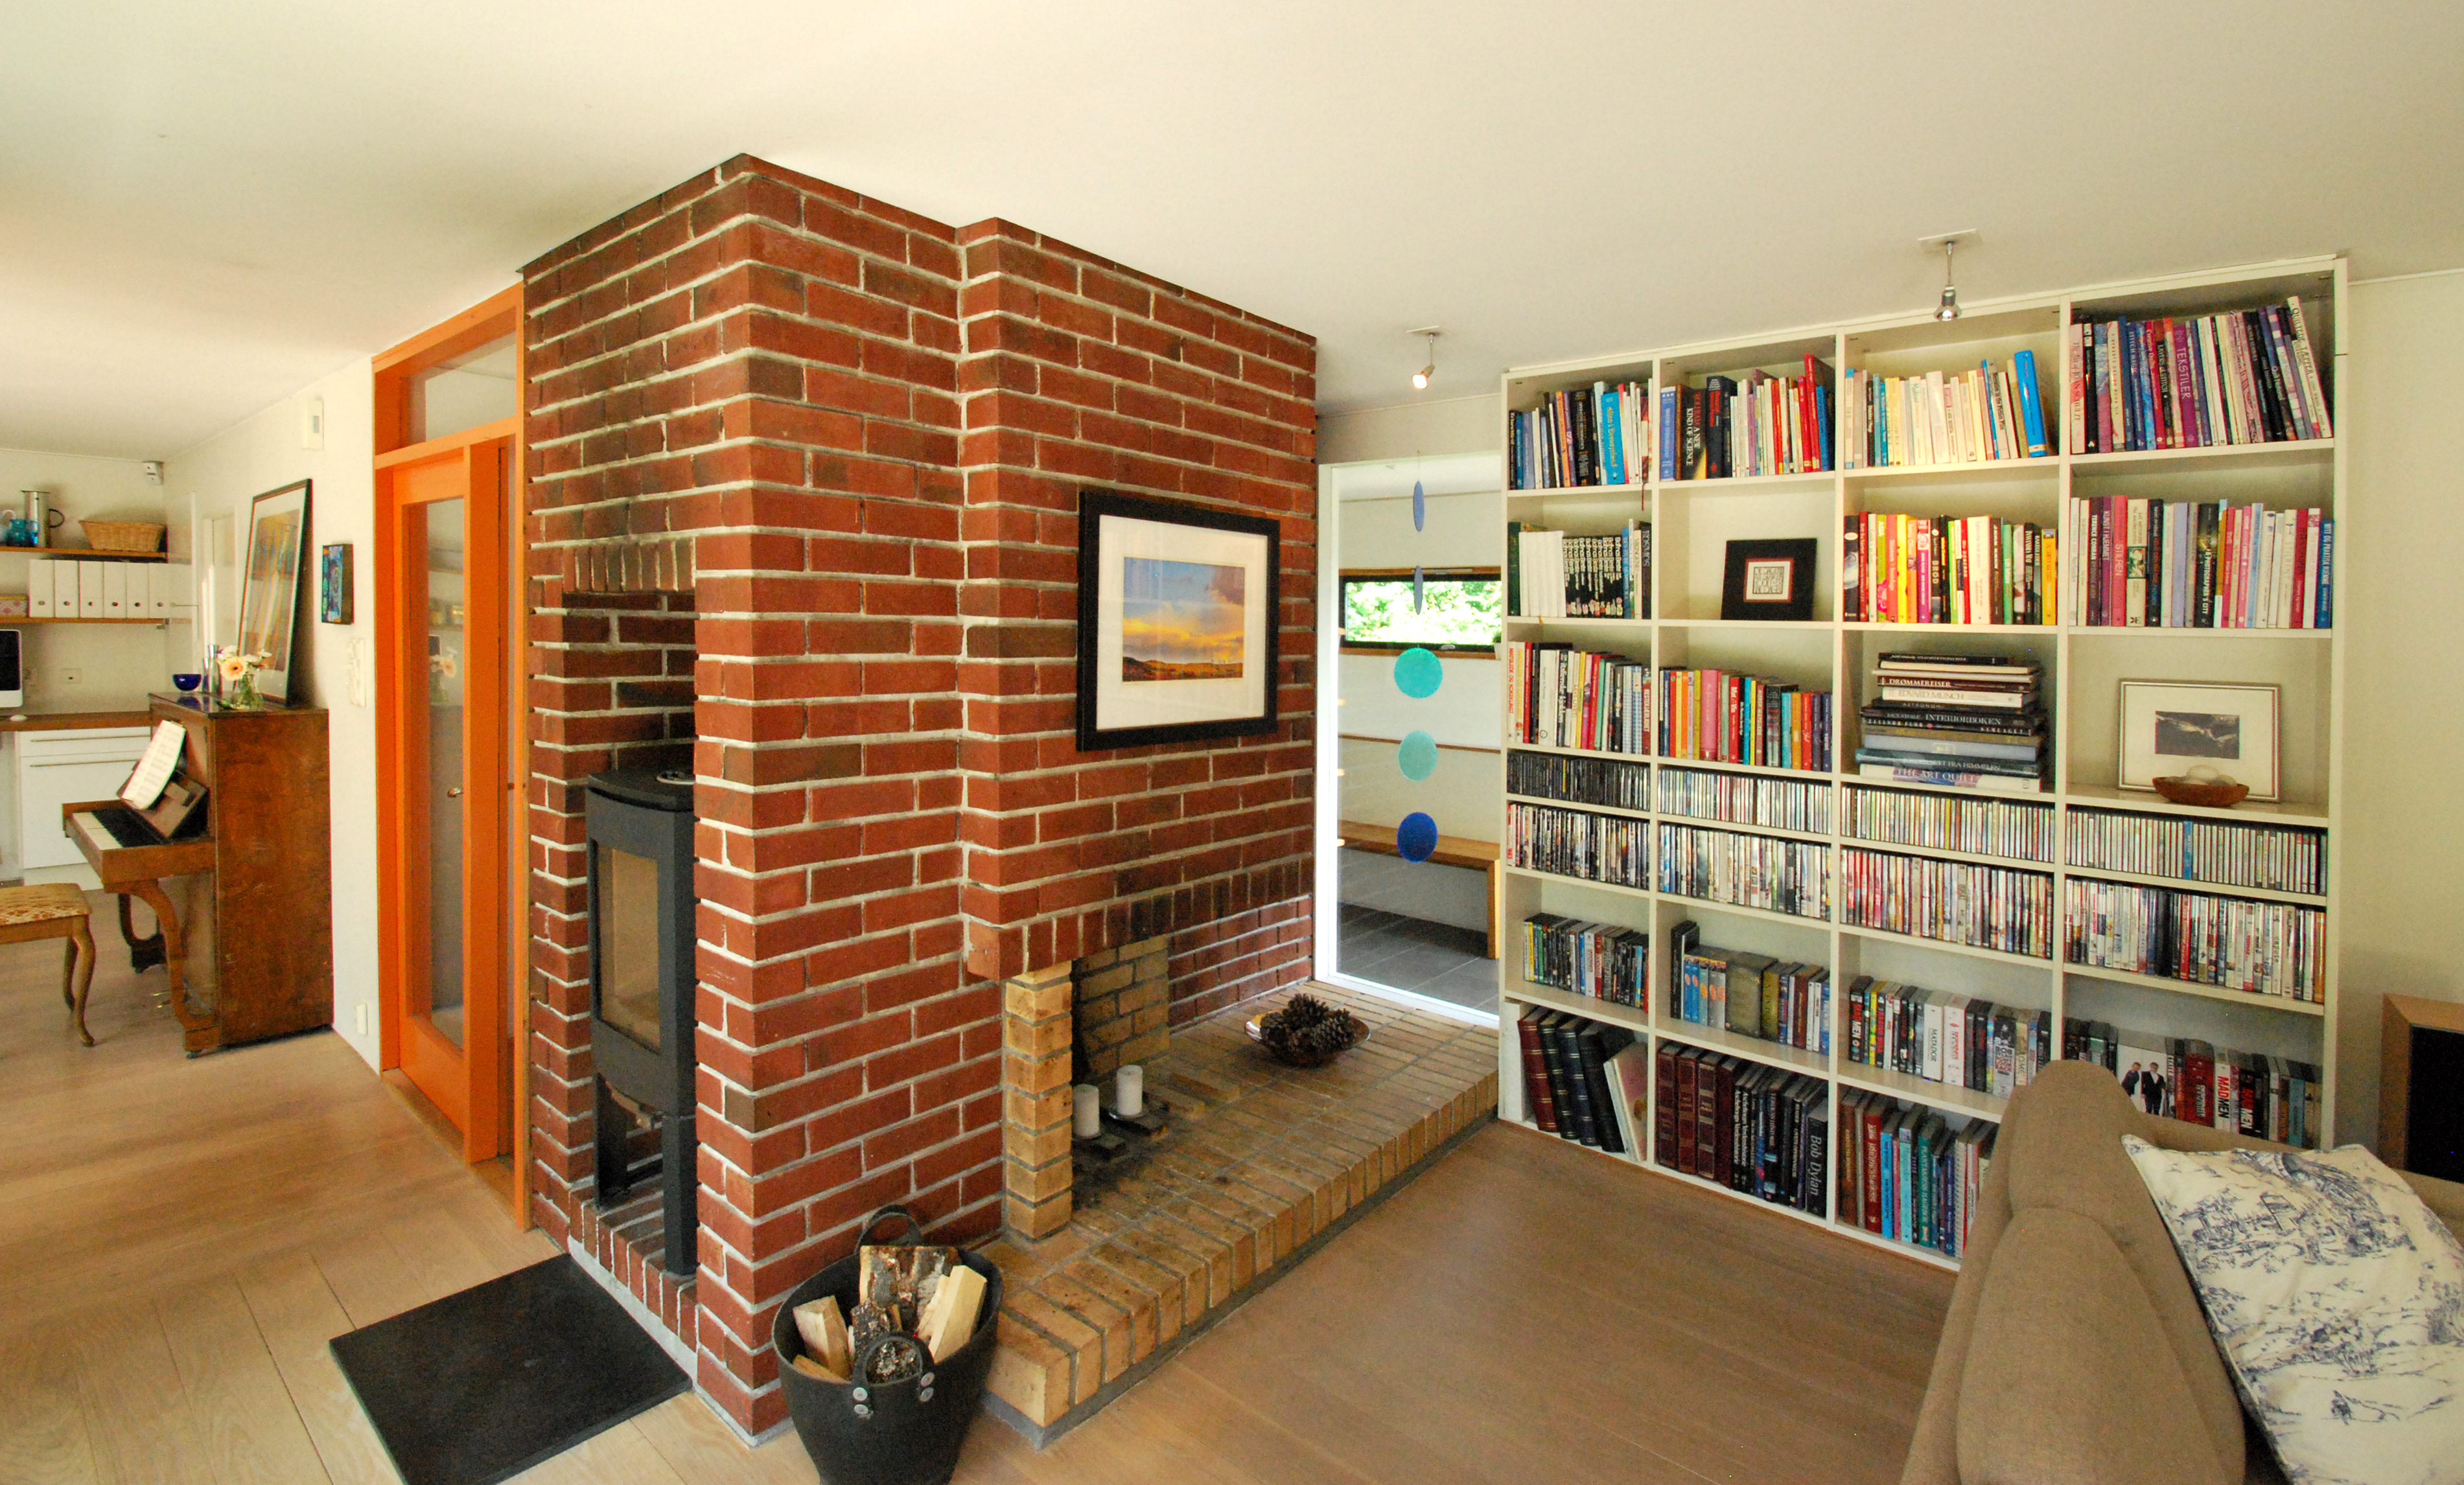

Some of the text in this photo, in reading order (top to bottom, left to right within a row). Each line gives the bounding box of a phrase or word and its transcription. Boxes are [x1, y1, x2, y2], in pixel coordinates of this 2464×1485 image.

[2146, 329, 2154, 351] Creative
[2291, 308, 2305, 341] QUILTEDE
[2176, 347, 2191, 400] TEKSTILER
[1693, 391, 1701, 426] WOLFRAM
[1686, 426, 1693, 437] OF
[1642, 530, 1650, 567] KOSMOS
[2115, 544, 2124, 576] STILREN
[1898, 691, 1964, 700] EDVARD MUNCH
[1897, 768, 1978, 782] THE ART QUILT
[1962, 761, 2001, 771] HIMMELEN
[1807, 1134, 1822, 1196] Bob Dylan
